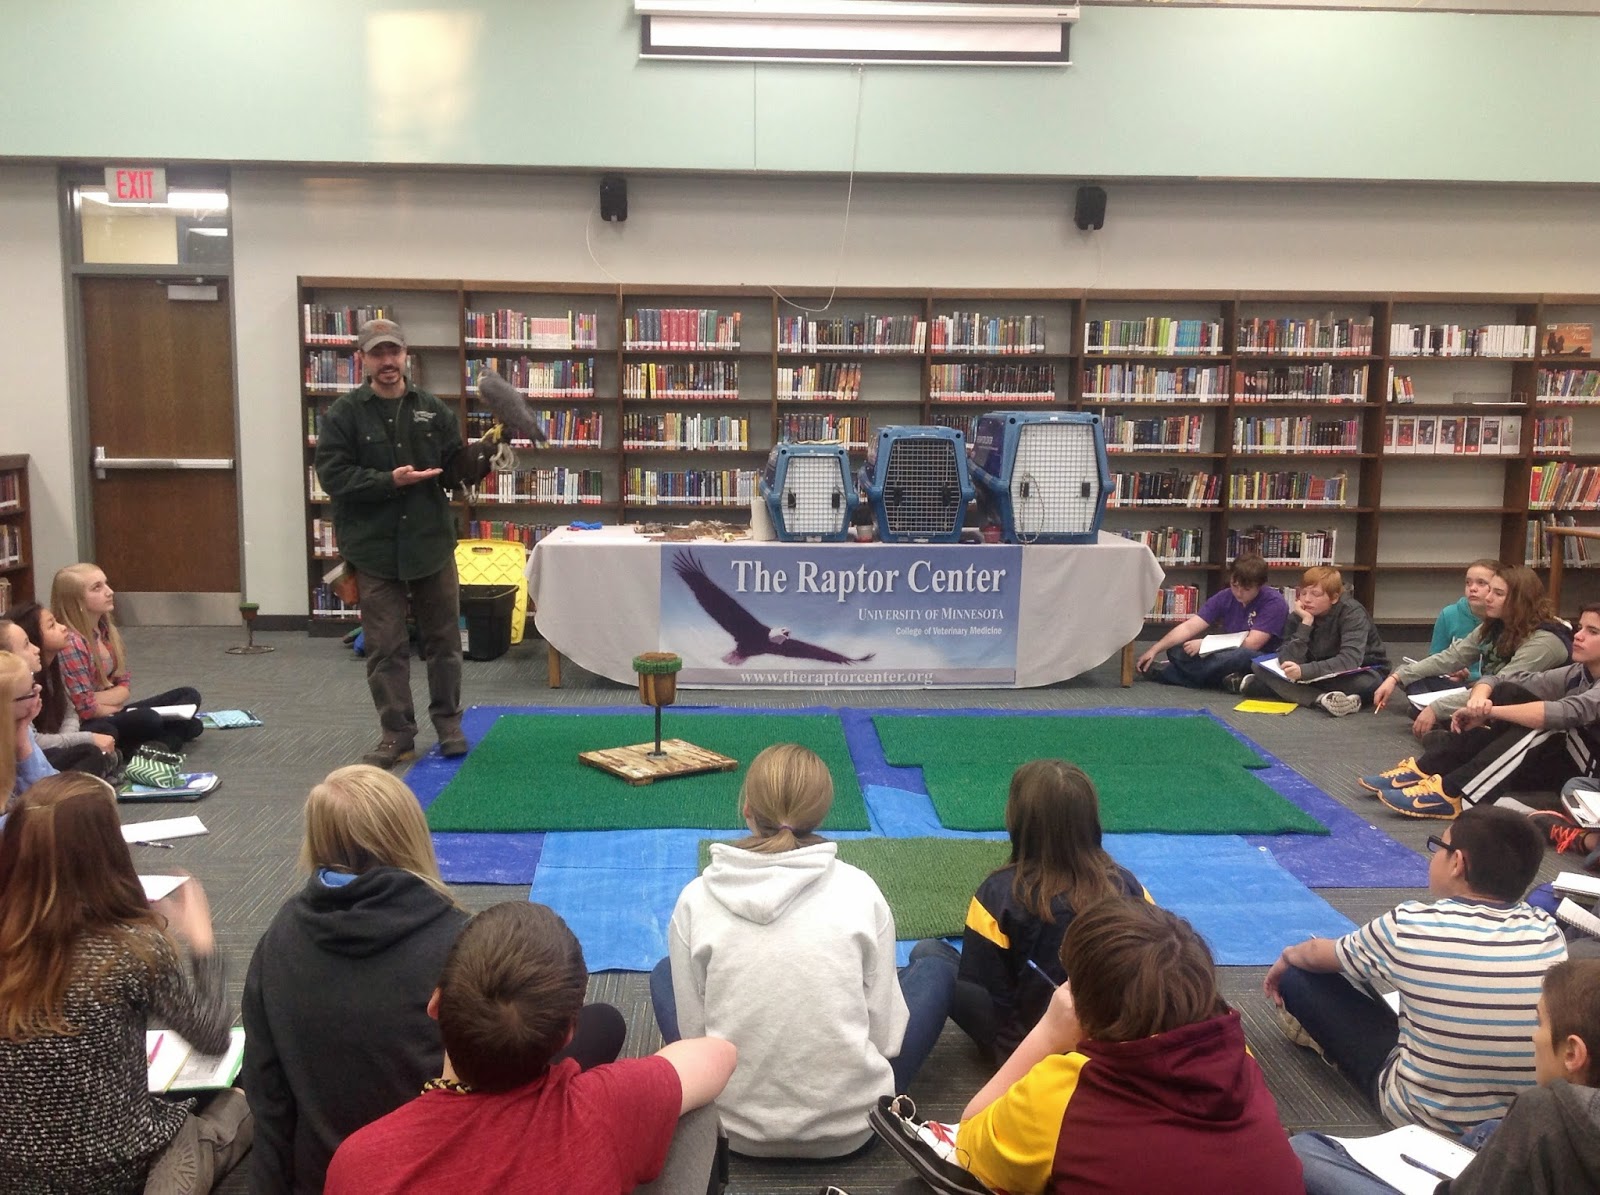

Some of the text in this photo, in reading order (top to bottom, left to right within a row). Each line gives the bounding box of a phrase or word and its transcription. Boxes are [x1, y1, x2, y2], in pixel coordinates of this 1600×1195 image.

[115, 170, 154, 199] EXIT
[731, 560, 1006, 603] The Raptor Center
[858, 607, 1004, 621] UNIVERSITY OF MINNESOTA
[895, 626, 1003, 637] College of Veterinary Medicine
[740, 670, 934, 686] www.theraptorcenter.org
